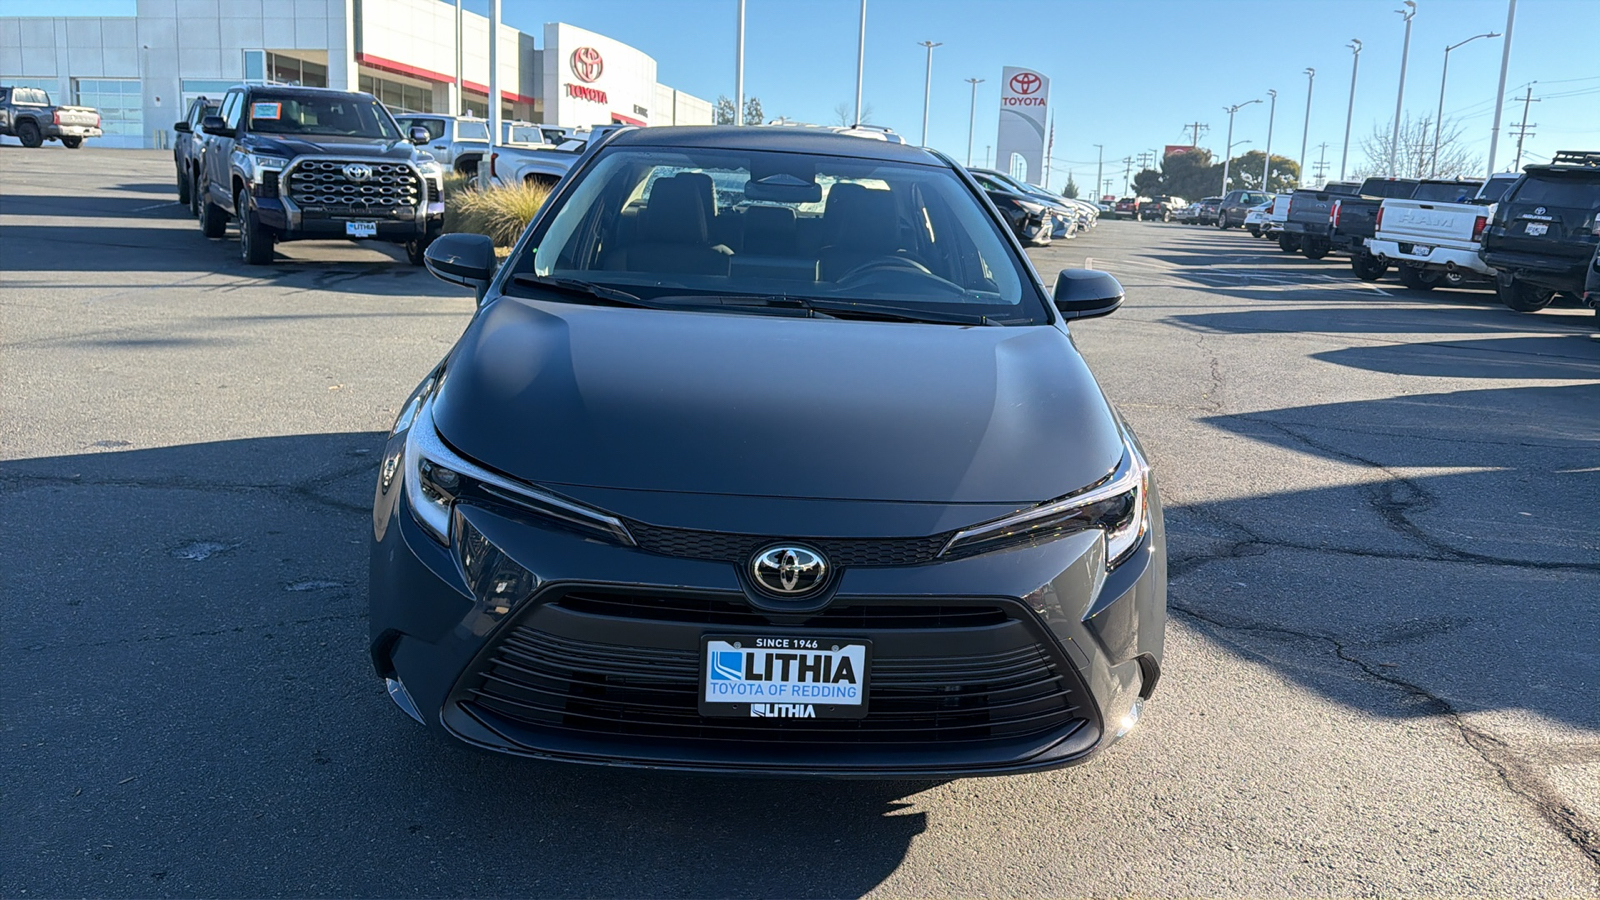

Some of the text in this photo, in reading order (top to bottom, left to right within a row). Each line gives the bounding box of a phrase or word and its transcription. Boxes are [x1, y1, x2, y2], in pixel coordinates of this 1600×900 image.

[565, 83, 608, 104] TOYOTA
[1003, 97, 1046, 106] TOYOTA
[1399, 214, 1455, 228] RAM
[756, 638, 818, 649] SINCE 1946
[745, 652, 857, 684] LITHIA
[710, 682, 857, 698] TOYOTA OF REDDING
[765, 703, 816, 718] LITHIA
